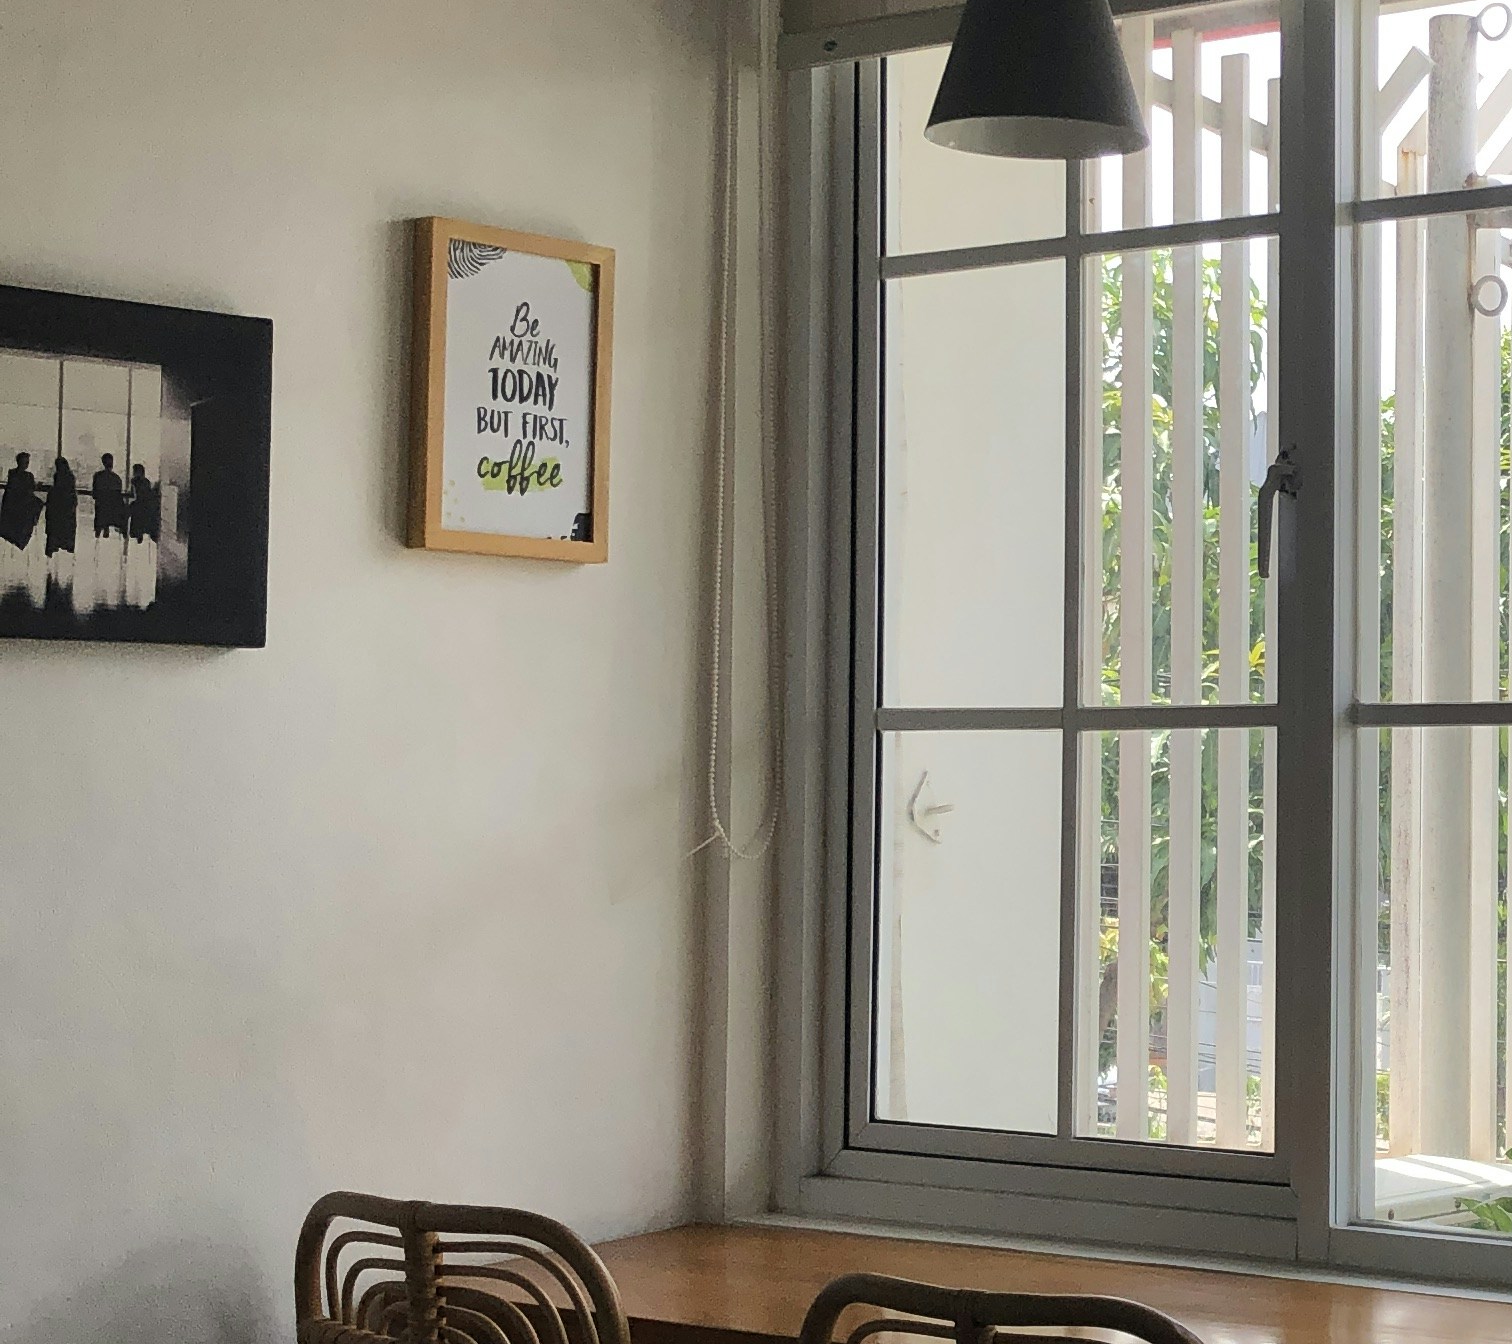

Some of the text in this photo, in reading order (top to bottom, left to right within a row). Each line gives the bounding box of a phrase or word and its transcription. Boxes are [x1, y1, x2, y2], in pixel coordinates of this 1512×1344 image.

[510, 302, 540, 338] Be
[489, 336, 559, 373] AMAZING
[488, 367, 559, 411] TODAY
[476, 406, 570, 448] BUT FIRST,
[477, 439, 563, 496] coffee
